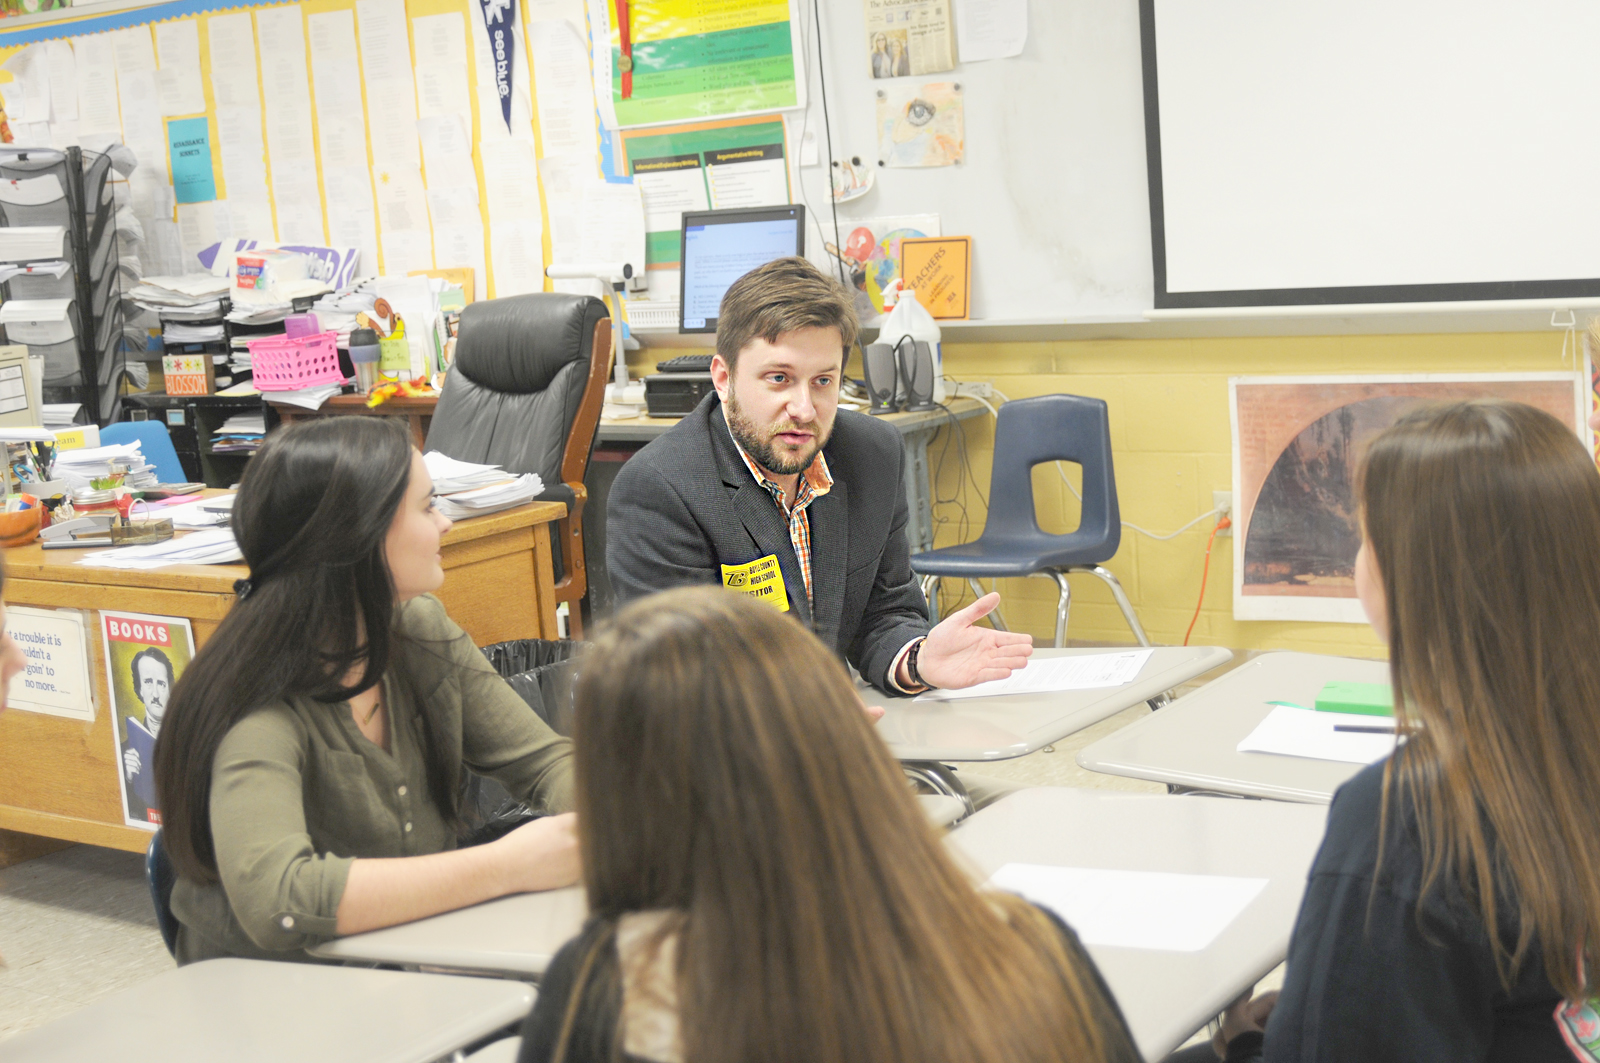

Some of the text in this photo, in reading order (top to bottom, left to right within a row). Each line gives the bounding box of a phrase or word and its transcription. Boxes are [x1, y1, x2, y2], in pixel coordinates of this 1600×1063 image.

[906, 247, 946, 290] TEACHERS
[165, 375, 208, 394] BLOSSOM
[56, 437, 76, 445] eam
[760, 559, 776, 570] COUNTY
[761, 570, 776, 581] SCHOOL
[742, 585, 773, 597] SITOR
[109, 620, 168, 642] BOOKS
[14, 632, 18, 640] a
[19, 632, 46, 644] trouble
[47, 634, 53, 645] it
[55, 634, 62, 646] is
[21, 646, 51, 660] uldn't a
[27, 663, 44, 676] goin'
[46, 665, 54, 676] to
[25, 679, 57, 692] no more.
